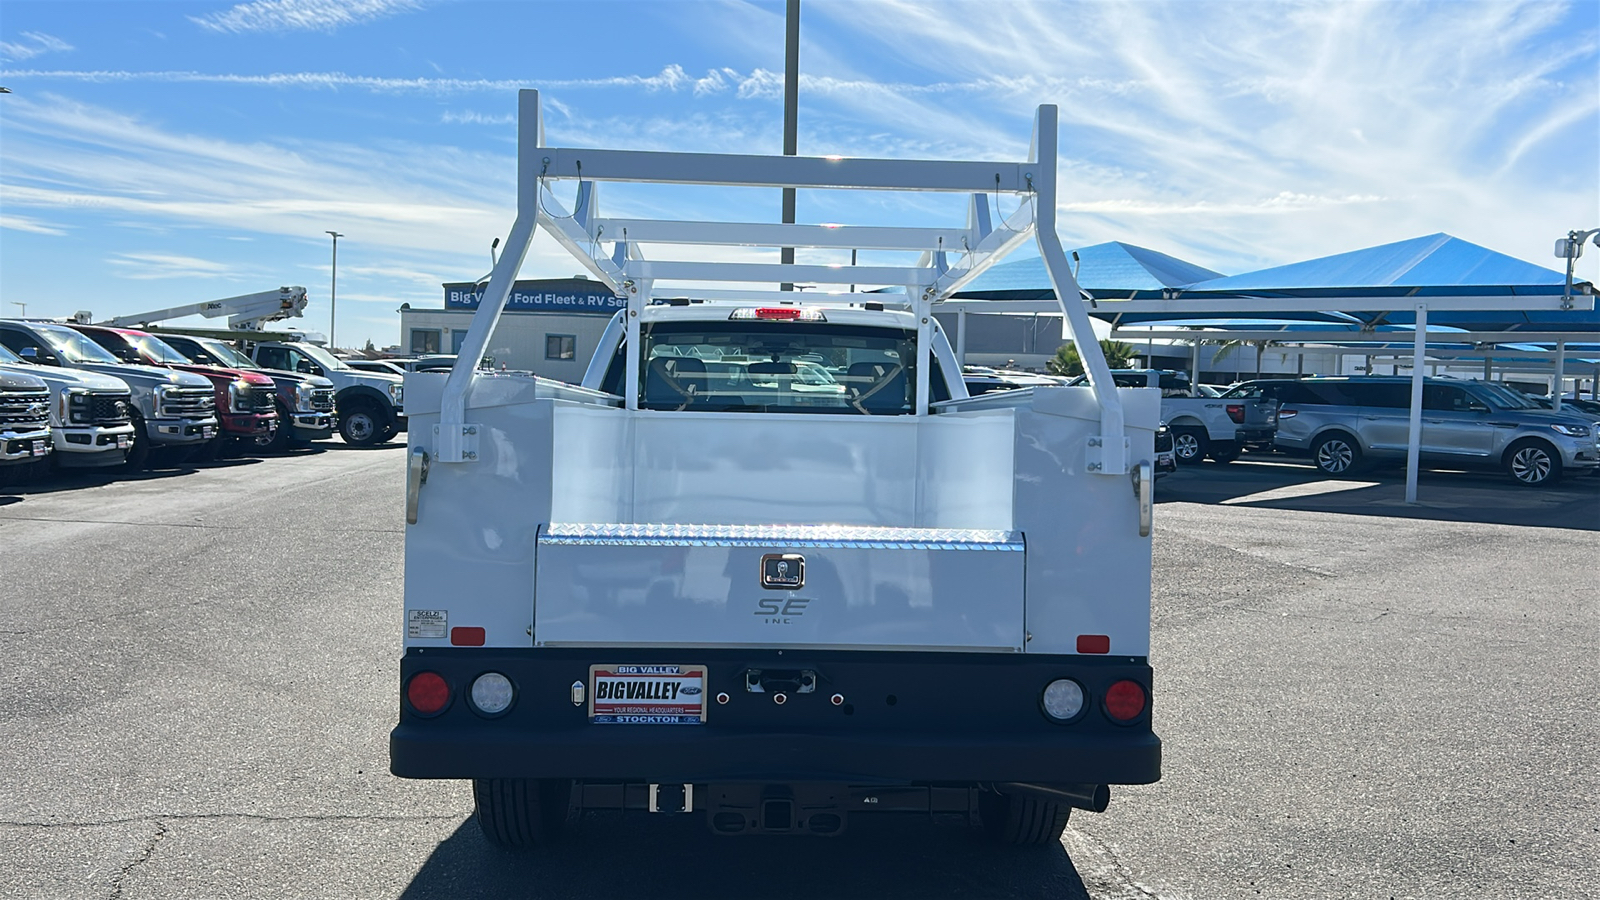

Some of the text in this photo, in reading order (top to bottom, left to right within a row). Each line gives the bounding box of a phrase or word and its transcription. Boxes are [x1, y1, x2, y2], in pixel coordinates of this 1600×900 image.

[451, 292, 471, 303] Big
[514, 293, 543, 304] Ford
[545, 294, 576, 305] Fleet
[587, 297, 606, 307] RV
[754, 598, 811, 615] SE
[596, 681, 681, 700] BIGVALLEY
